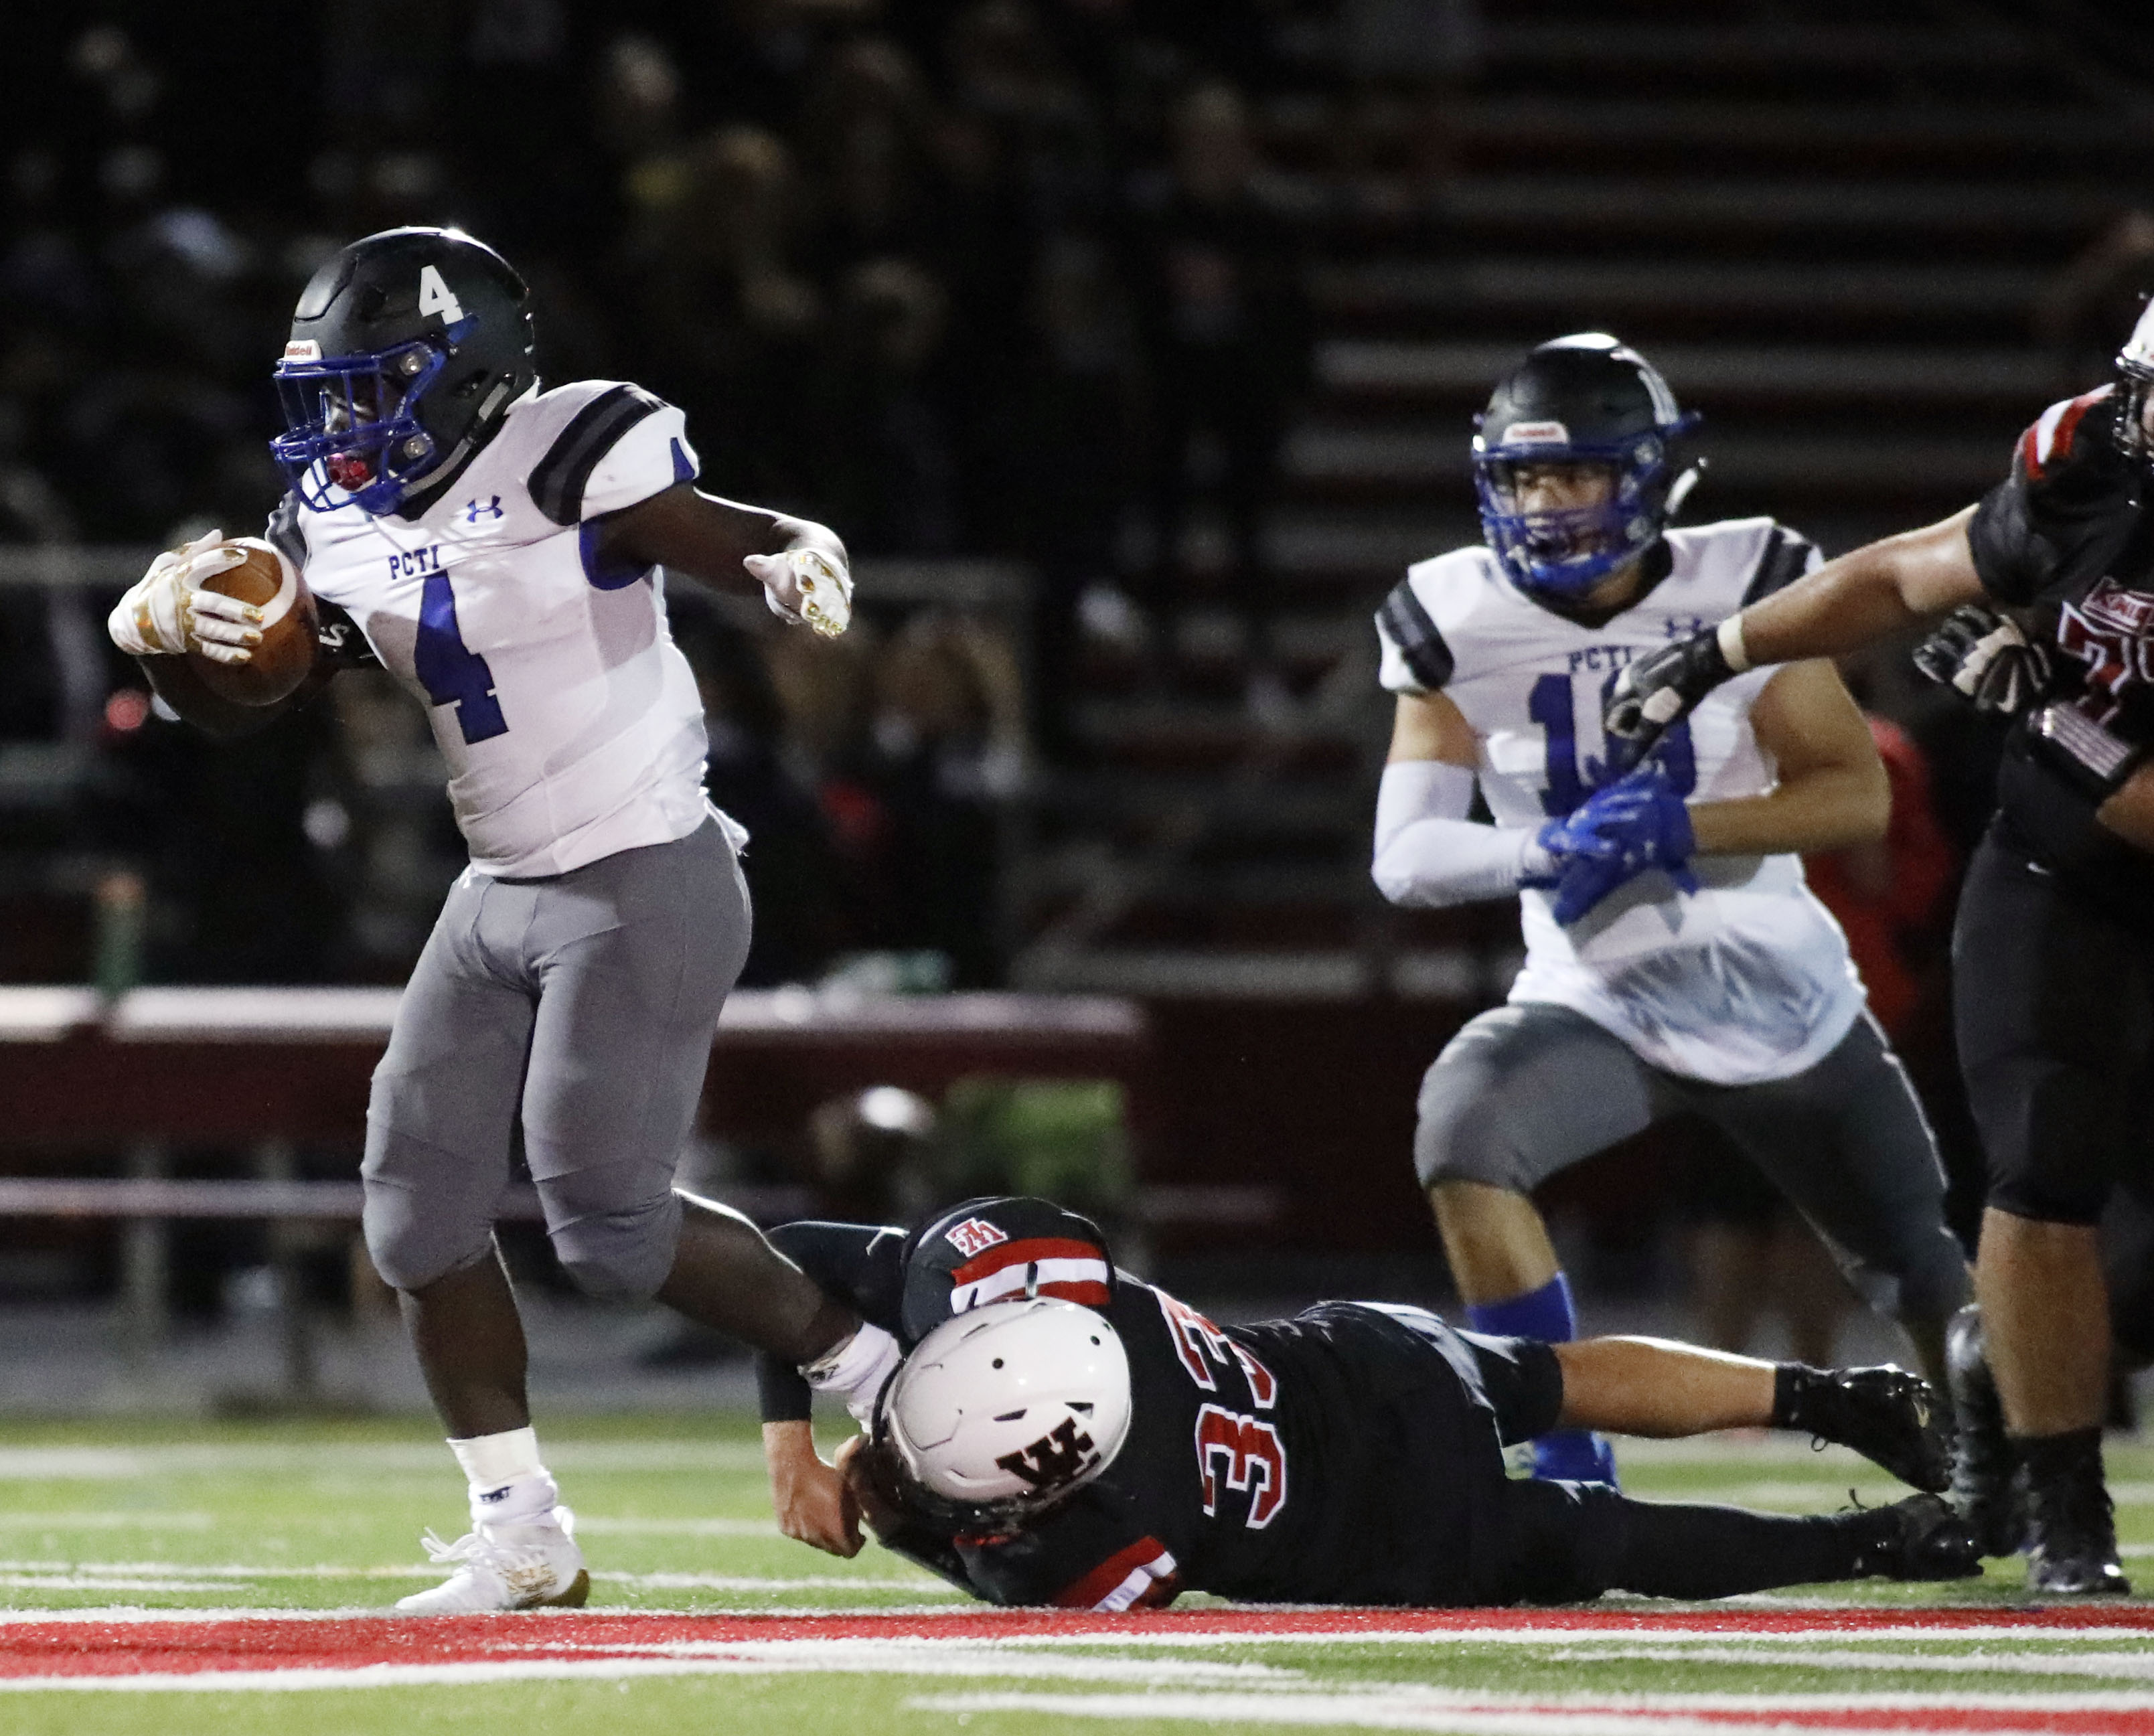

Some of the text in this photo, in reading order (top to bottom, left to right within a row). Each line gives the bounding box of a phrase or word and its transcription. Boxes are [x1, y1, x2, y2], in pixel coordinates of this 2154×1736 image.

[418, 264, 464, 325] 4
[388, 545, 439, 580] PCTI
[414, 569, 510, 746] 4
[1148, 1284, 1286, 1529] 33
